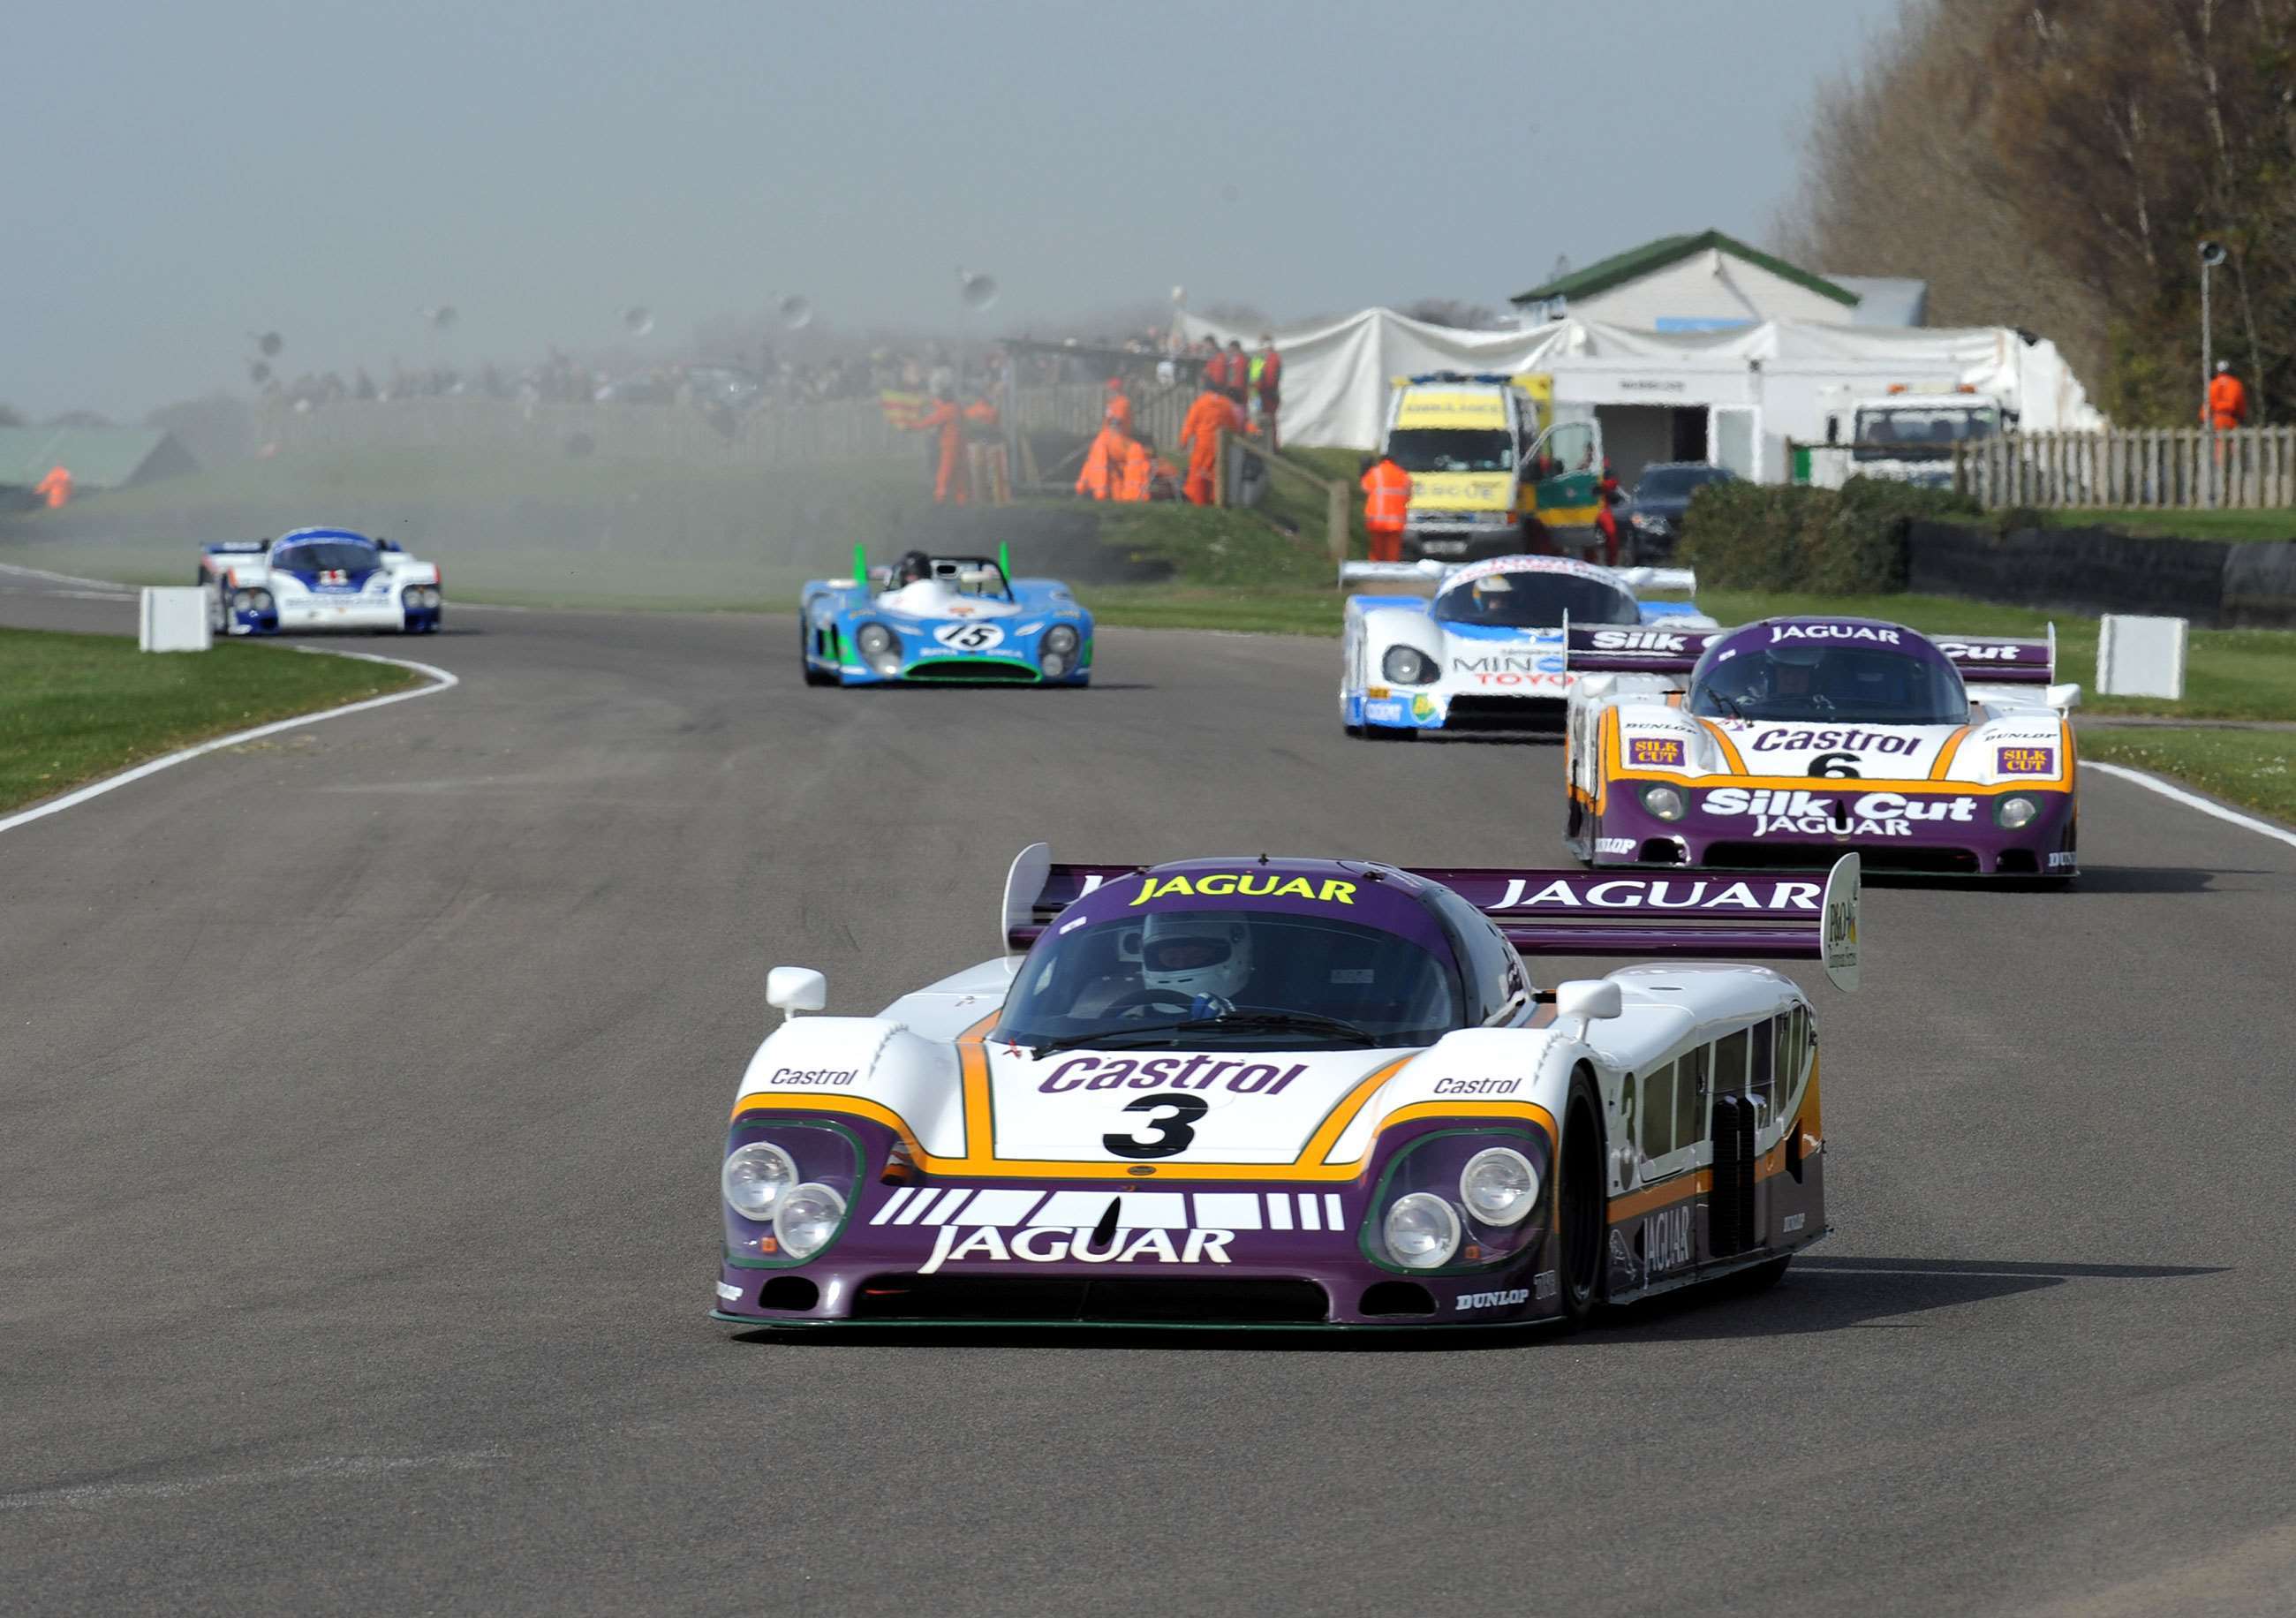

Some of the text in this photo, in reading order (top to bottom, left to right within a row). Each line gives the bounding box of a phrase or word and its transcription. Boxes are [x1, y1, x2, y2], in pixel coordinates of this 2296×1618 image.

[944, 624, 998, 647] 15
[1591, 631, 1688, 652] Silk
[1770, 625, 1900, 645] JAGUAR
[1938, 642, 2020, 660] Cut
[1453, 656, 1567, 673] MINO
[1475, 672, 1575, 686] TOYO
[1625, 722, 1697, 735] DUNLOP
[1985, 732, 2058, 742] DUNLOP
[1635, 740, 1679, 752] SILK
[1752, 728, 1923, 756] Castrol
[1638, 752, 1677, 763] CUT
[2004, 749, 2047, 760] SILK
[1808, 752, 1863, 779] 6
[2005, 760, 2045, 772] CUT
[1702, 788, 1977, 821] Silk Cut
[1752, 814, 1913, 837] JAGUAR
[1128, 873, 1358, 906] JAGUAR
[1489, 879, 1823, 910] JAGUAR
[770, 1068, 859, 1086] Castrol
[1038, 1055, 1308, 1096] Castrol
[1433, 1077, 1523, 1095] Castrol
[1102, 1093, 1209, 1160] 3
[916, 1224, 1235, 1274] JAGUAR
[1643, 1206, 1690, 1290] JAGUAR
[1454, 1289, 1529, 1311] DUNLOP
